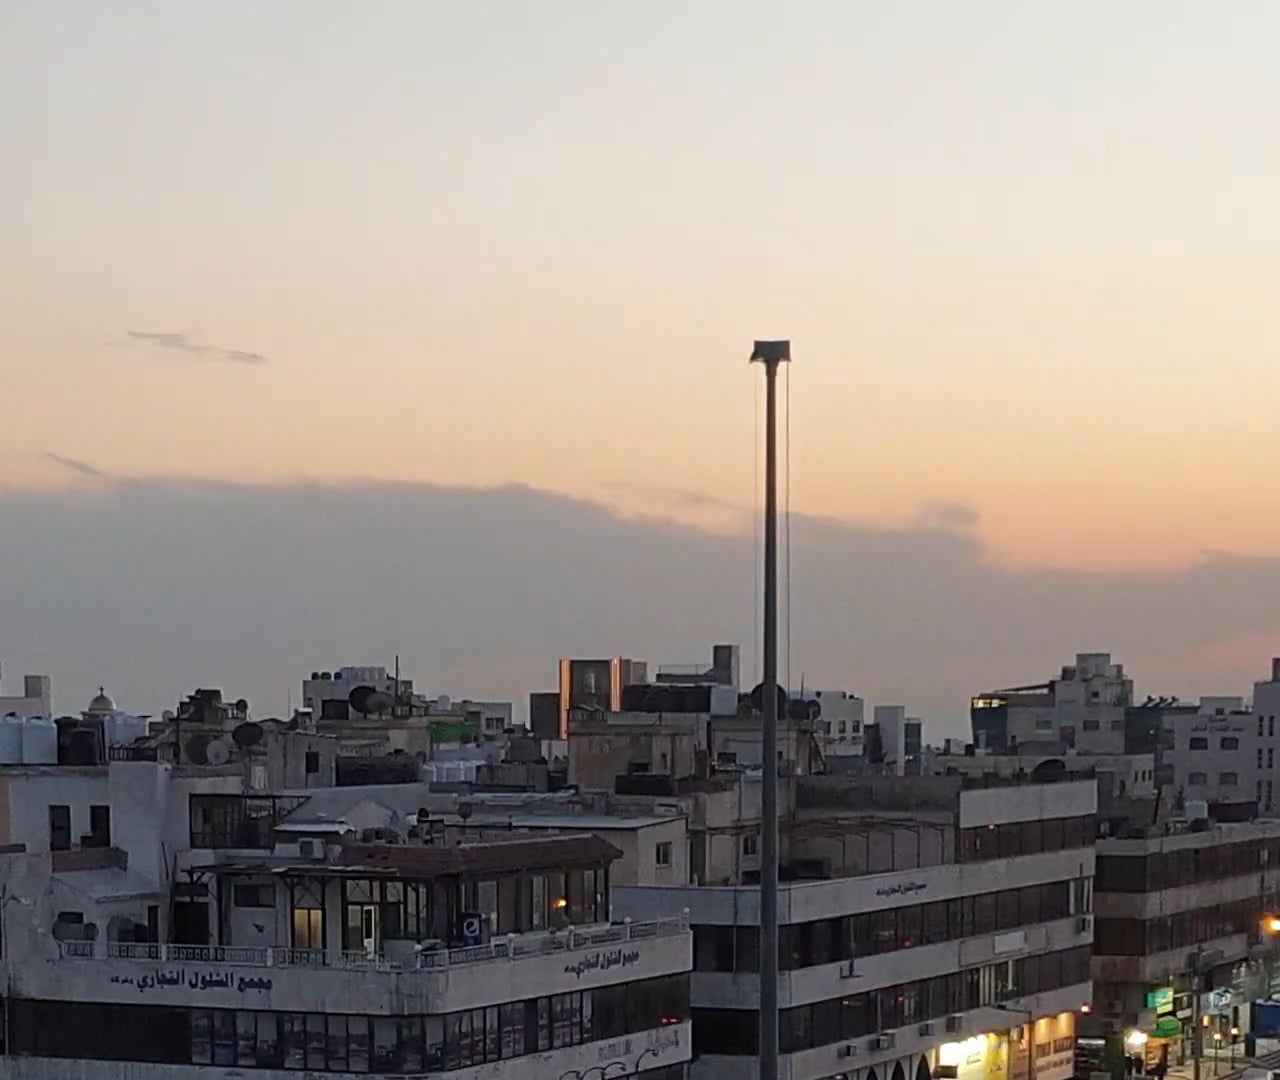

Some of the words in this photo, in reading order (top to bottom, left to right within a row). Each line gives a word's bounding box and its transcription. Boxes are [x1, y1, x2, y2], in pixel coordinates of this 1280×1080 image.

[136, 967, 185, 993] التجاري
[188, 970, 234, 990] الشلول
[237, 974, 273, 993] مجمع
